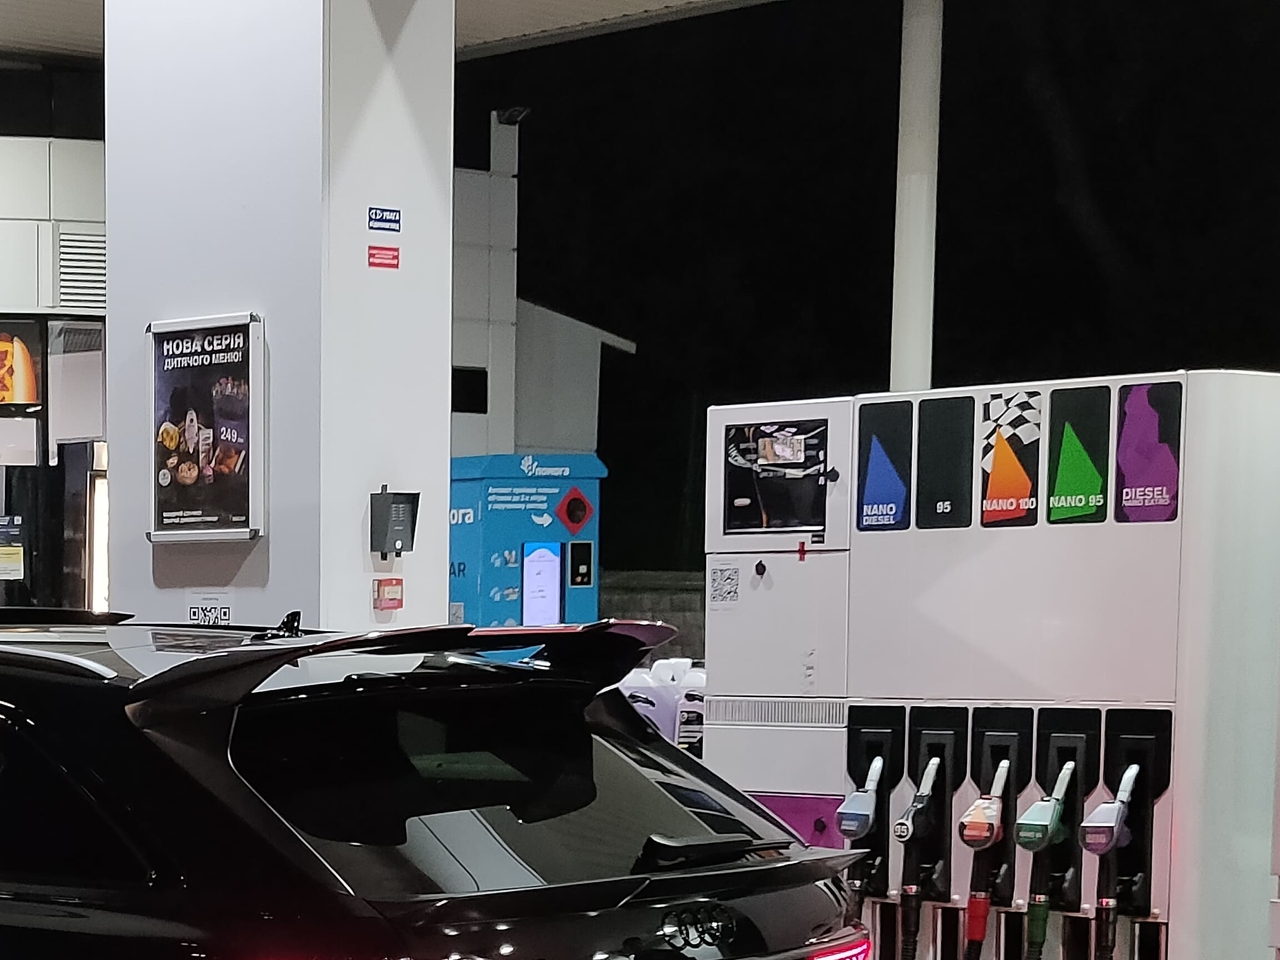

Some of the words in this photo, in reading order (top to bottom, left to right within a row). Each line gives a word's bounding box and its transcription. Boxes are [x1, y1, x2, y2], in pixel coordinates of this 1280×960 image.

[163, 338, 202, 356] НОВА
[204, 333, 244, 352] СЕРІЯ
[164, 354, 210, 371] ДИТЯЧОГО
[212, 351, 242, 364] МЕНЮ!
[220, 426, 238, 443] 249
[1122, 486, 1170, 500] DIESEL
[936, 501, 952, 513] 95
[982, 498, 1017, 511] NANO
[1019, 497, 1037, 510] 100
[1049, 495, 1086, 508] NANO
[1088, 494, 1104, 506] 95
[863, 503, 896, 516] NANO
[863, 515, 896, 525] DIESEL
[894, 824, 908, 836] 95
